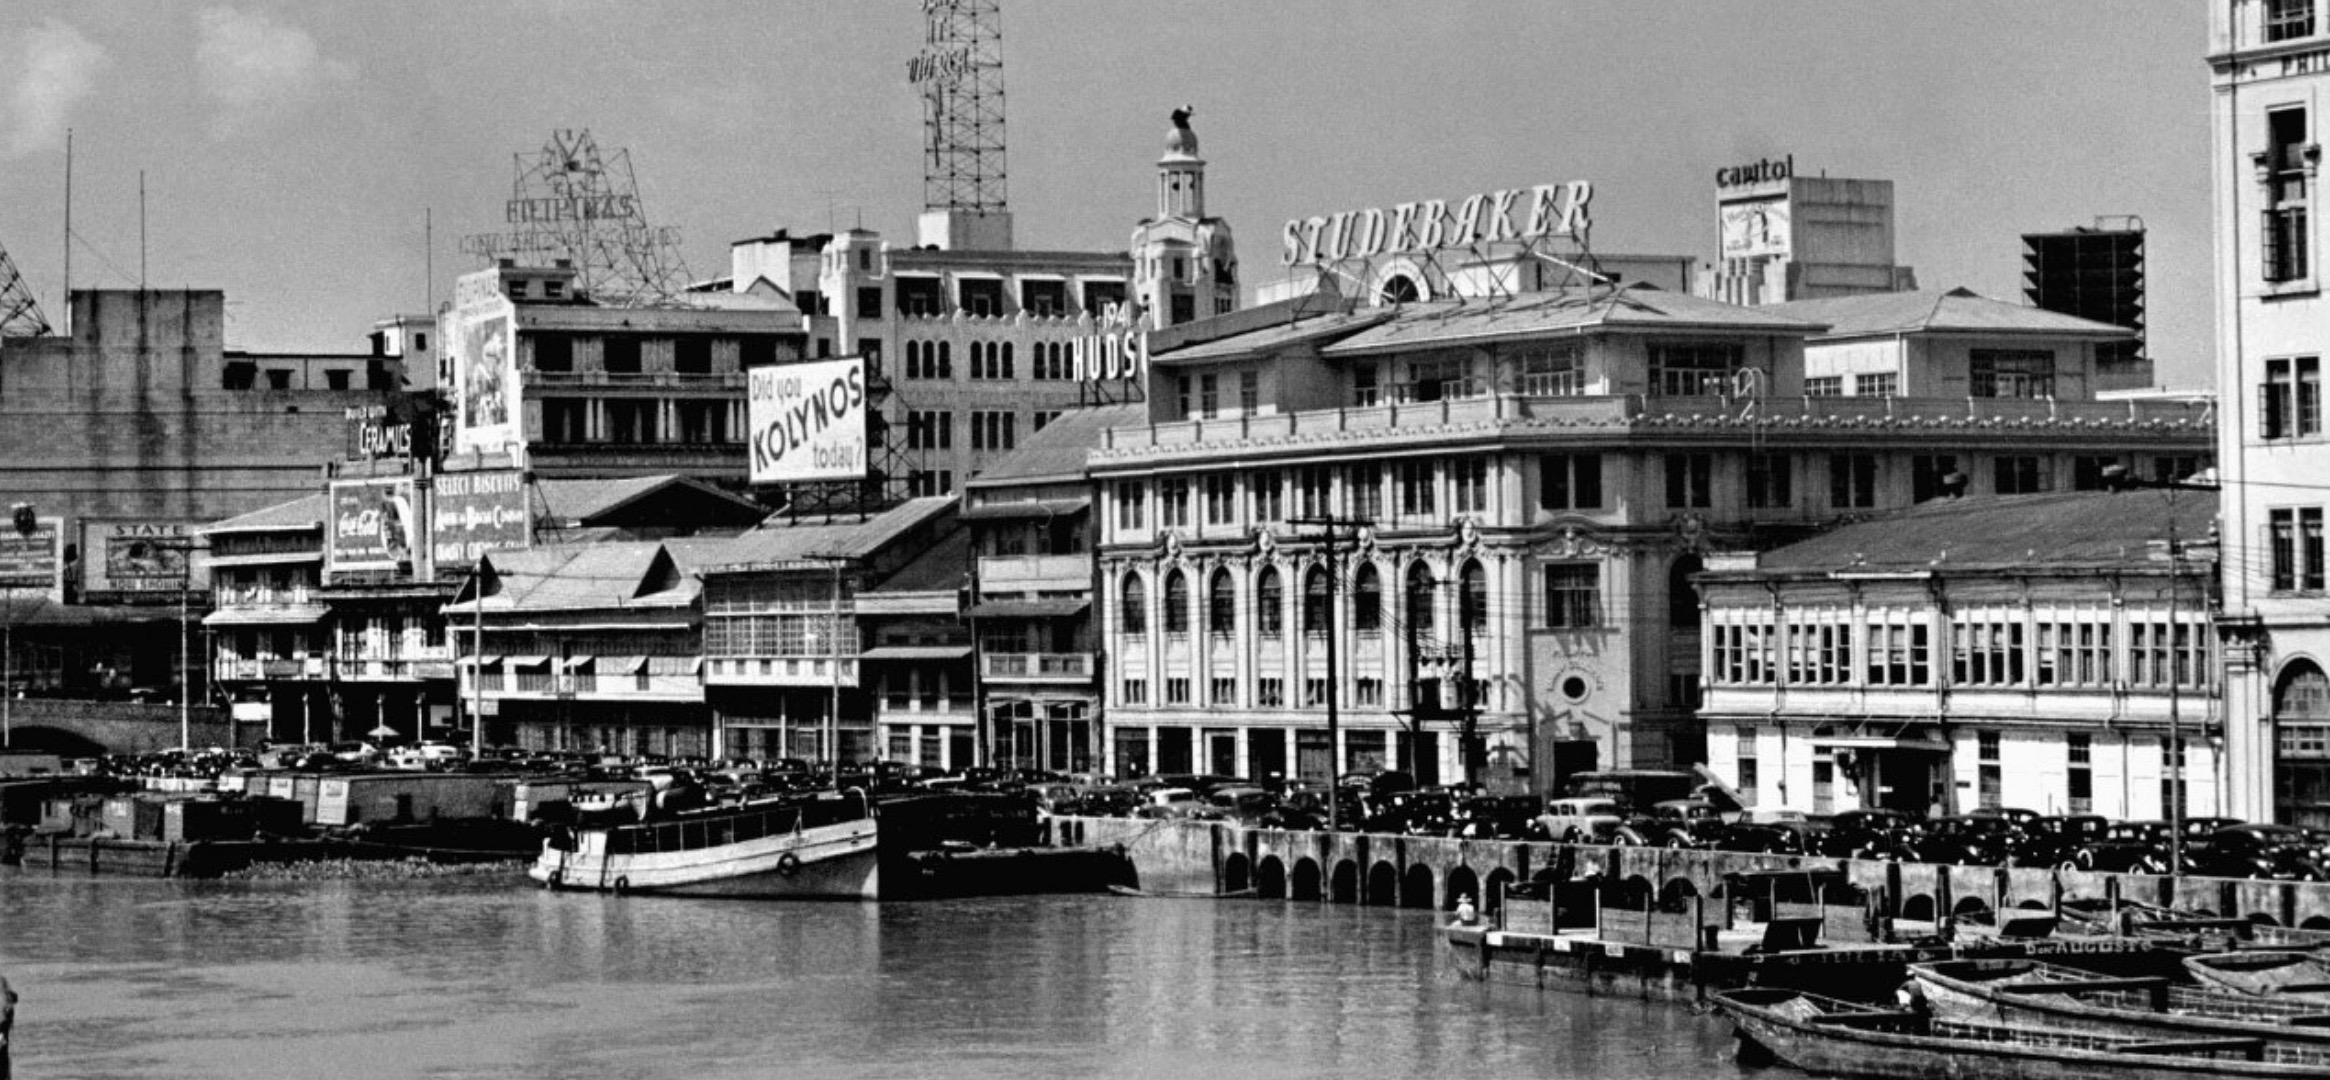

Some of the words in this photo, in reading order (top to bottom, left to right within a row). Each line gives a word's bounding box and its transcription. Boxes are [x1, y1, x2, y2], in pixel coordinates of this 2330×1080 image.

[506, 195, 634, 223] FILIPINAS
[1282, 180, 1593, 266] STUDEBAKER
[752, 372, 773, 402] Did
[777, 375, 803, 405] you
[753, 365, 863, 473] KOLYNOS
[359, 421, 412, 455] CERAMICS
[812, 435, 863, 473] today?
[435, 474, 469, 497] SELECT
[473, 472, 521, 495] BISCUITS
[115, 524, 184, 536] STATE
